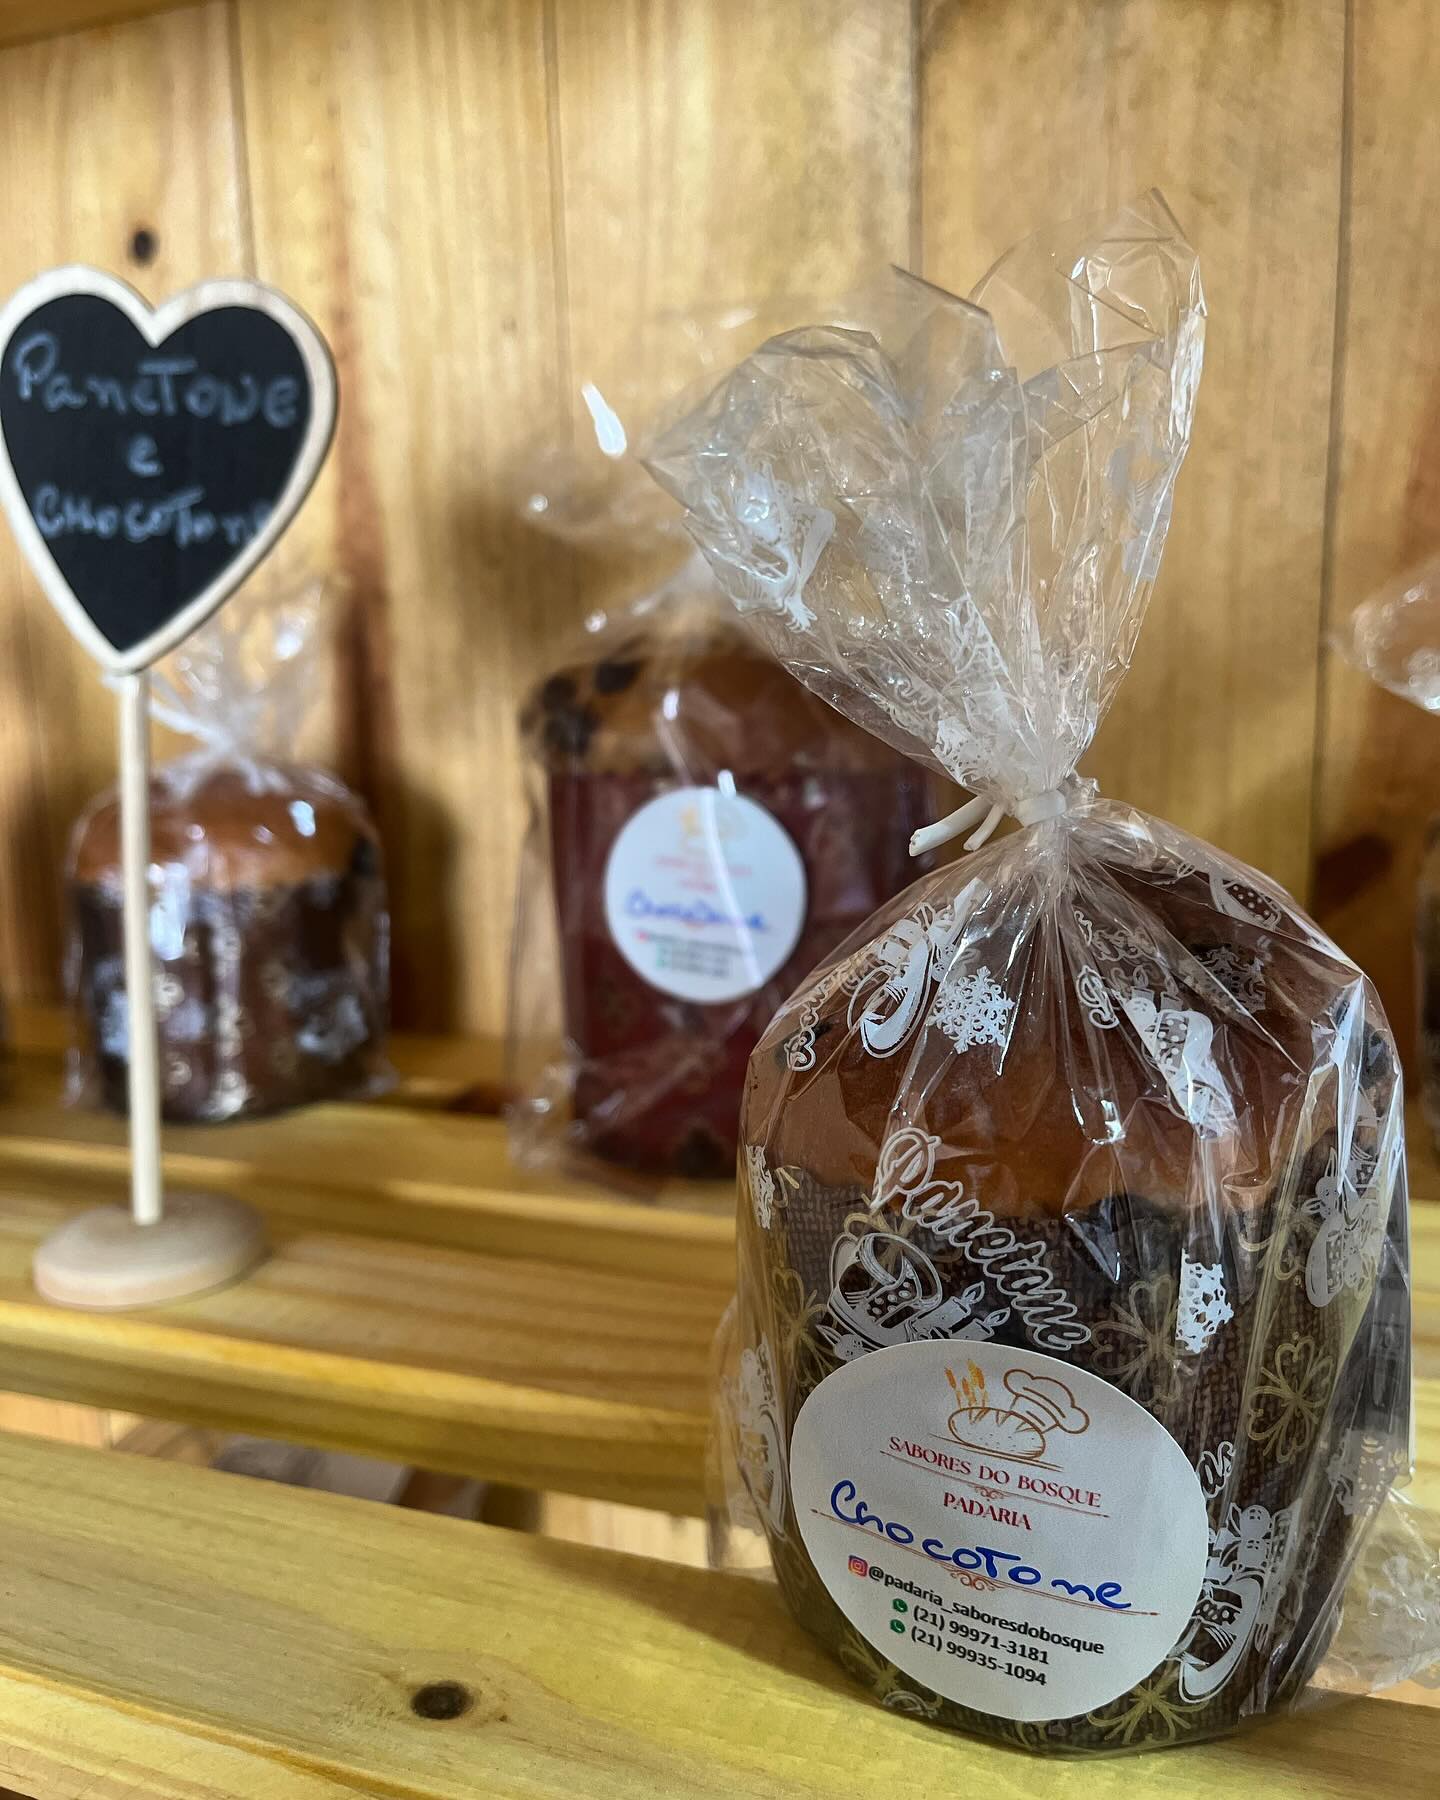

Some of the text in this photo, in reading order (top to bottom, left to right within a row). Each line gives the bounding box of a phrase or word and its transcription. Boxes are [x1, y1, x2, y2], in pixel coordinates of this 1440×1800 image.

[889, 1436, 1102, 1508] SABORES DO BOSQUE
[943, 1492, 1032, 1530] PADARIA
[869, 1566, 1105, 1655] @padaria_saboresdobosque
[913, 1605, 1050, 1665] (21) 99971-3181
[910, 1626, 1048, 1686] (21) 99935-1094
